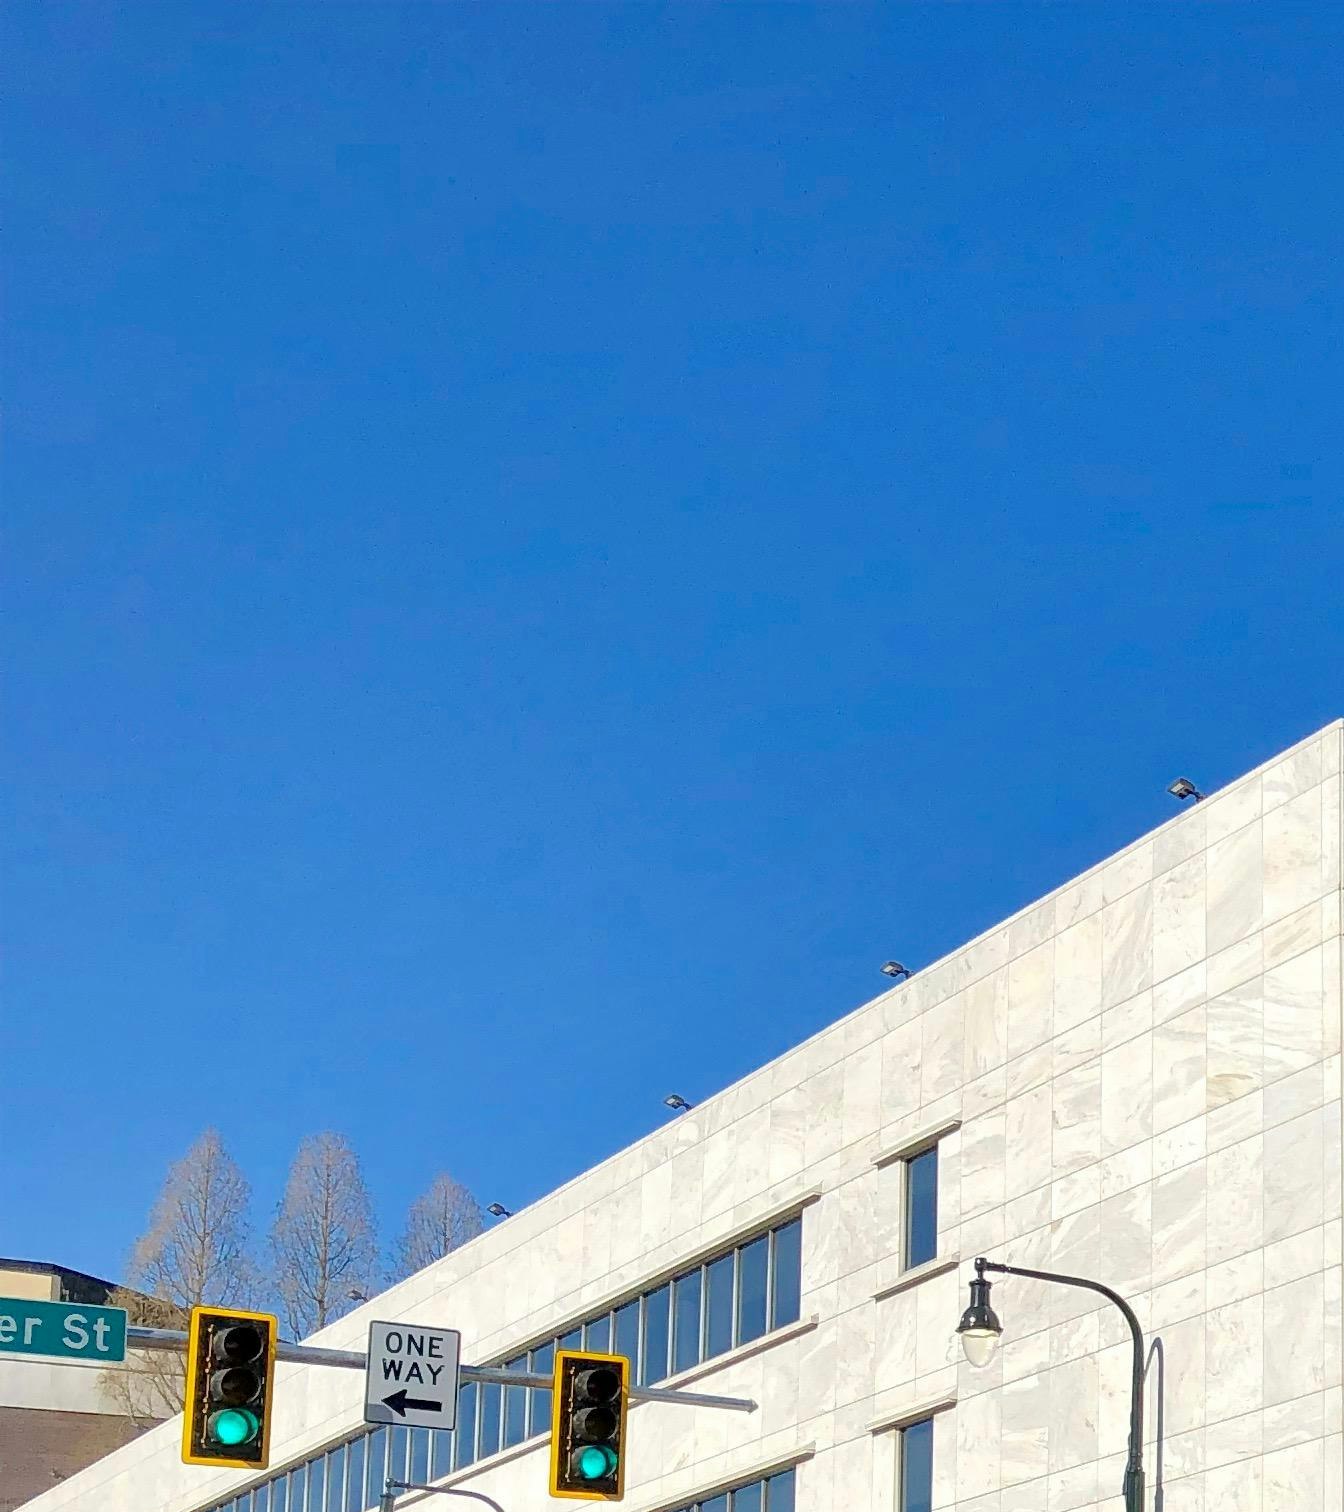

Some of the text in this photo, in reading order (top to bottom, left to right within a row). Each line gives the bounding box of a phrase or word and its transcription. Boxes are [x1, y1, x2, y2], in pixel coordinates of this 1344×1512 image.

[62, 1313, 111, 1352] St
[385, 1331, 444, 1358] ONE
[382, 1358, 445, 1385] WAY
